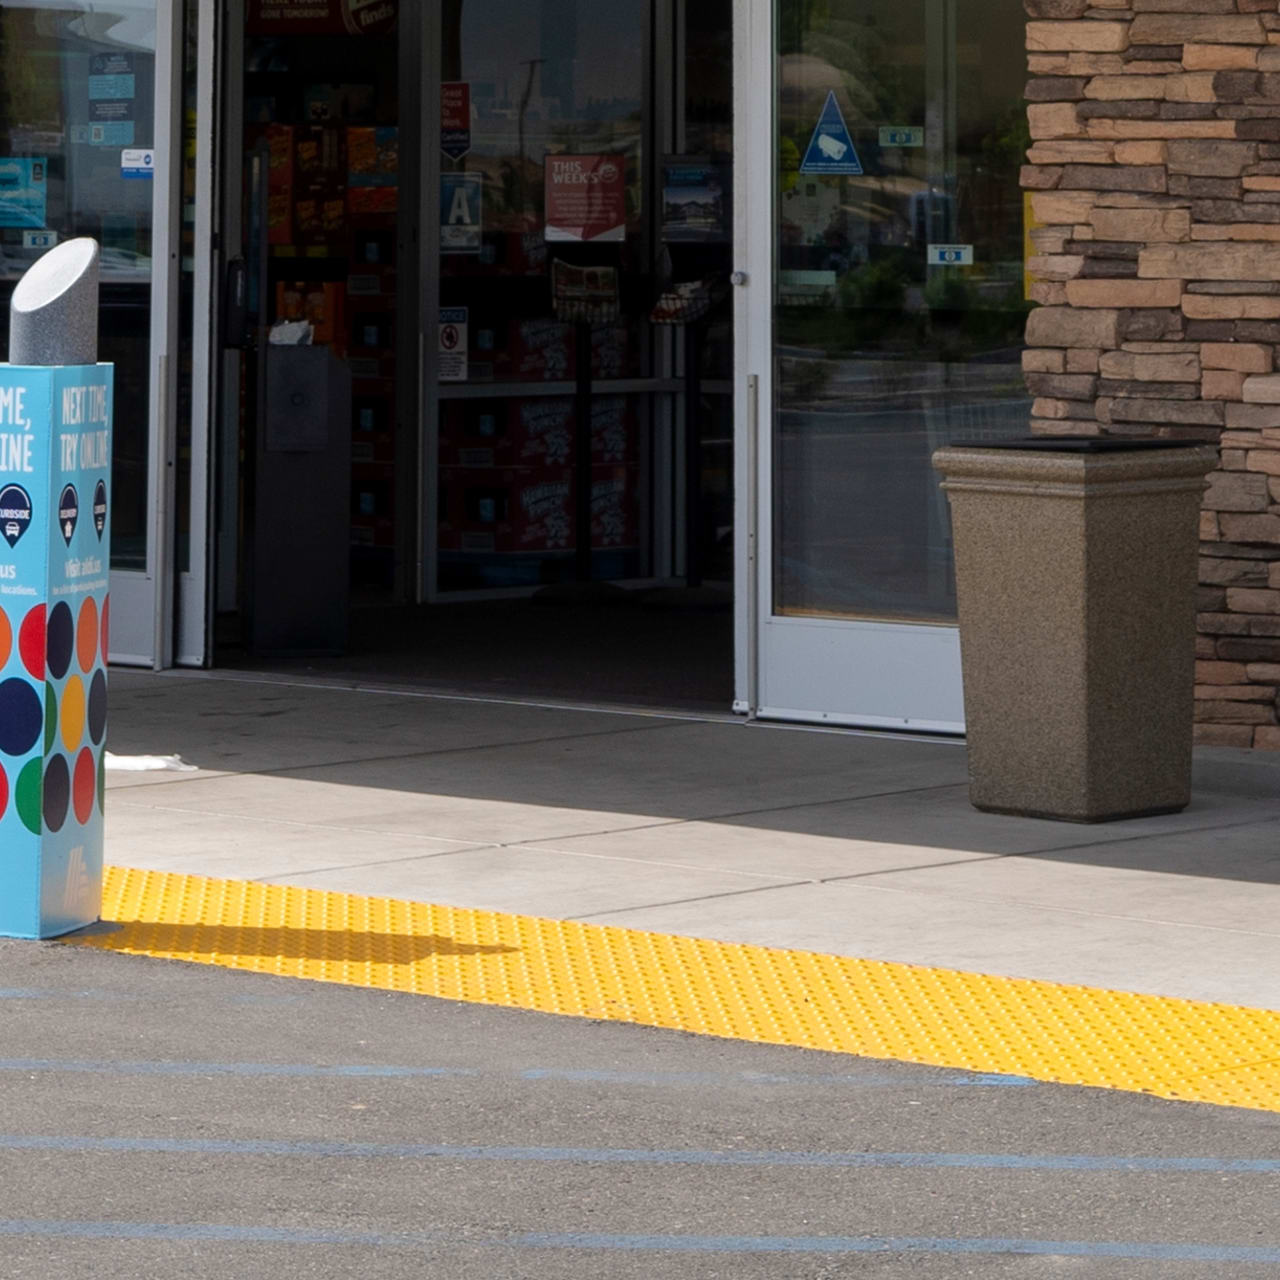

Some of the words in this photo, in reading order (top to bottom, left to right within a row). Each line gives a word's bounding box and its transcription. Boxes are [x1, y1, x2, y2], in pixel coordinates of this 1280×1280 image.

[359, 3, 395, 26] finds
[552, 172, 600, 185] WEEK'S
[553, 160, 582, 172] THIS
[447, 186, 472, 225] A
[62, 386, 87, 424] NEXT
[60, 432, 78, 472] TRY
